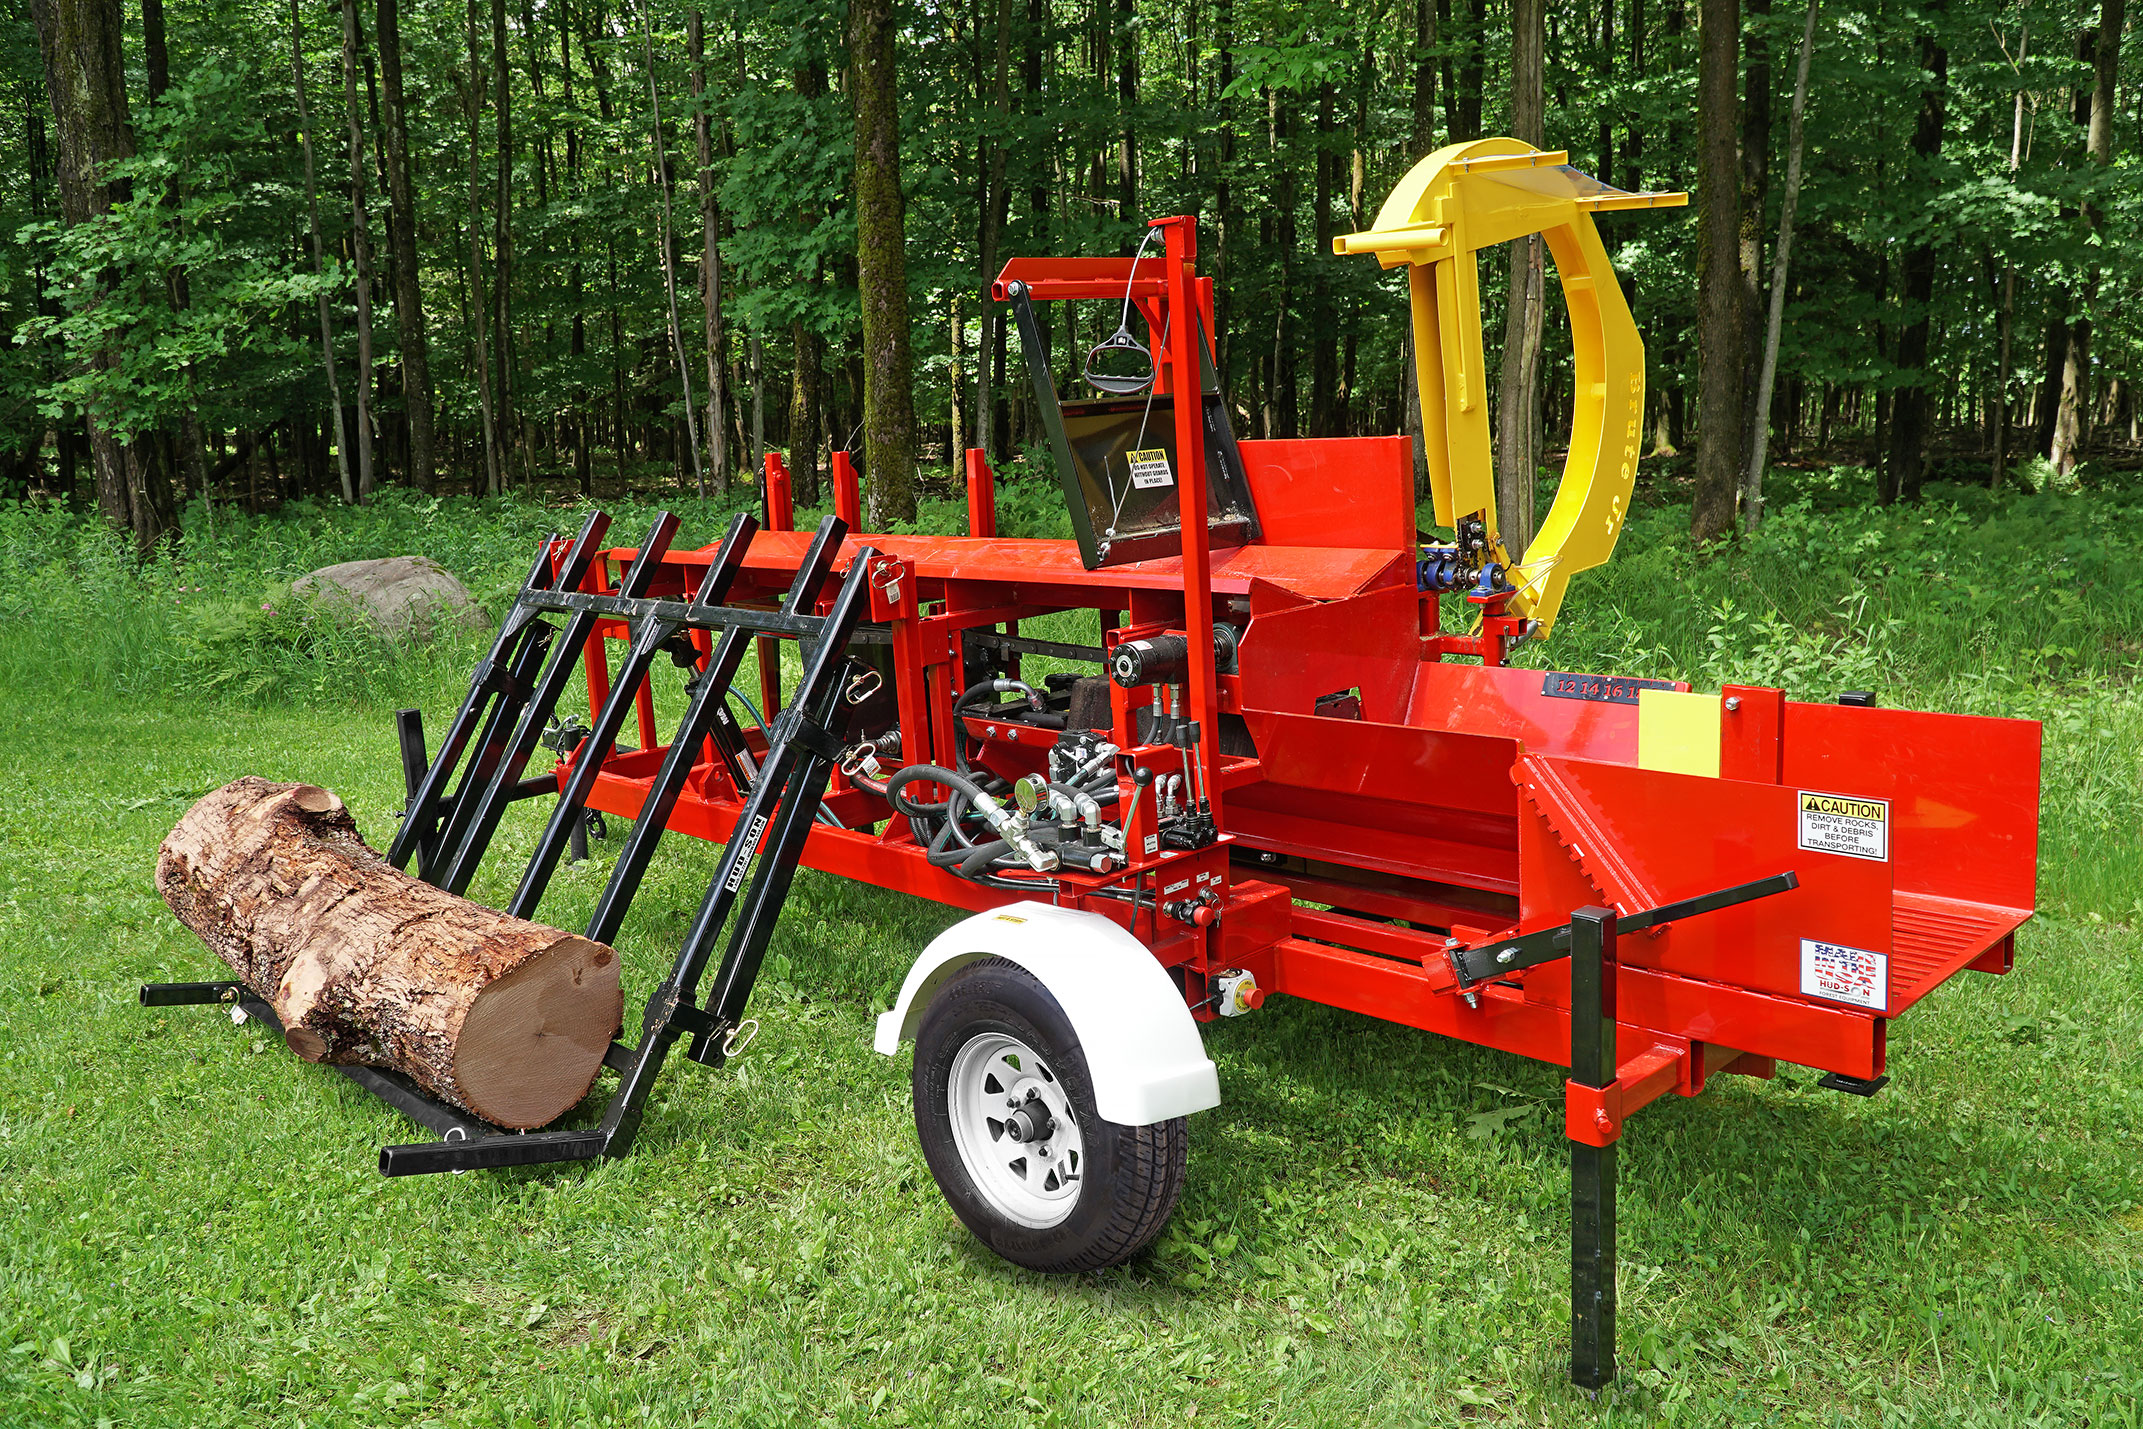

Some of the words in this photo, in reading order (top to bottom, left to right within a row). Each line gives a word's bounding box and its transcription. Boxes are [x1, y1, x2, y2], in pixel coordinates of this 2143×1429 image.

[1621, 372, 1641, 480] Brute
[1139, 450, 1165, 462] CAUTION
[1605, 495, 1622, 535] Jr
[1557, 680, 1576, 694] 12
[1580, 682, 1599, 696] 14
[1603, 684, 1623, 698] 16
[1821, 799, 1881, 819] CAUTION
[1806, 813, 1843, 825] REMOVE
[1845, 819, 1879, 831] ROCKS,
[1811, 822, 1831, 831] DIRT
[1841, 827, 1874, 838] DEBRIS
[1807, 838, 1878, 854] TRANSPORTING!
[1824, 833, 1860, 844] BEFORE
[1814, 969, 1876, 990] USA
[1819, 990, 1838, 999] FOREST
[1838, 995, 1870, 1006] EQUIPMENT
